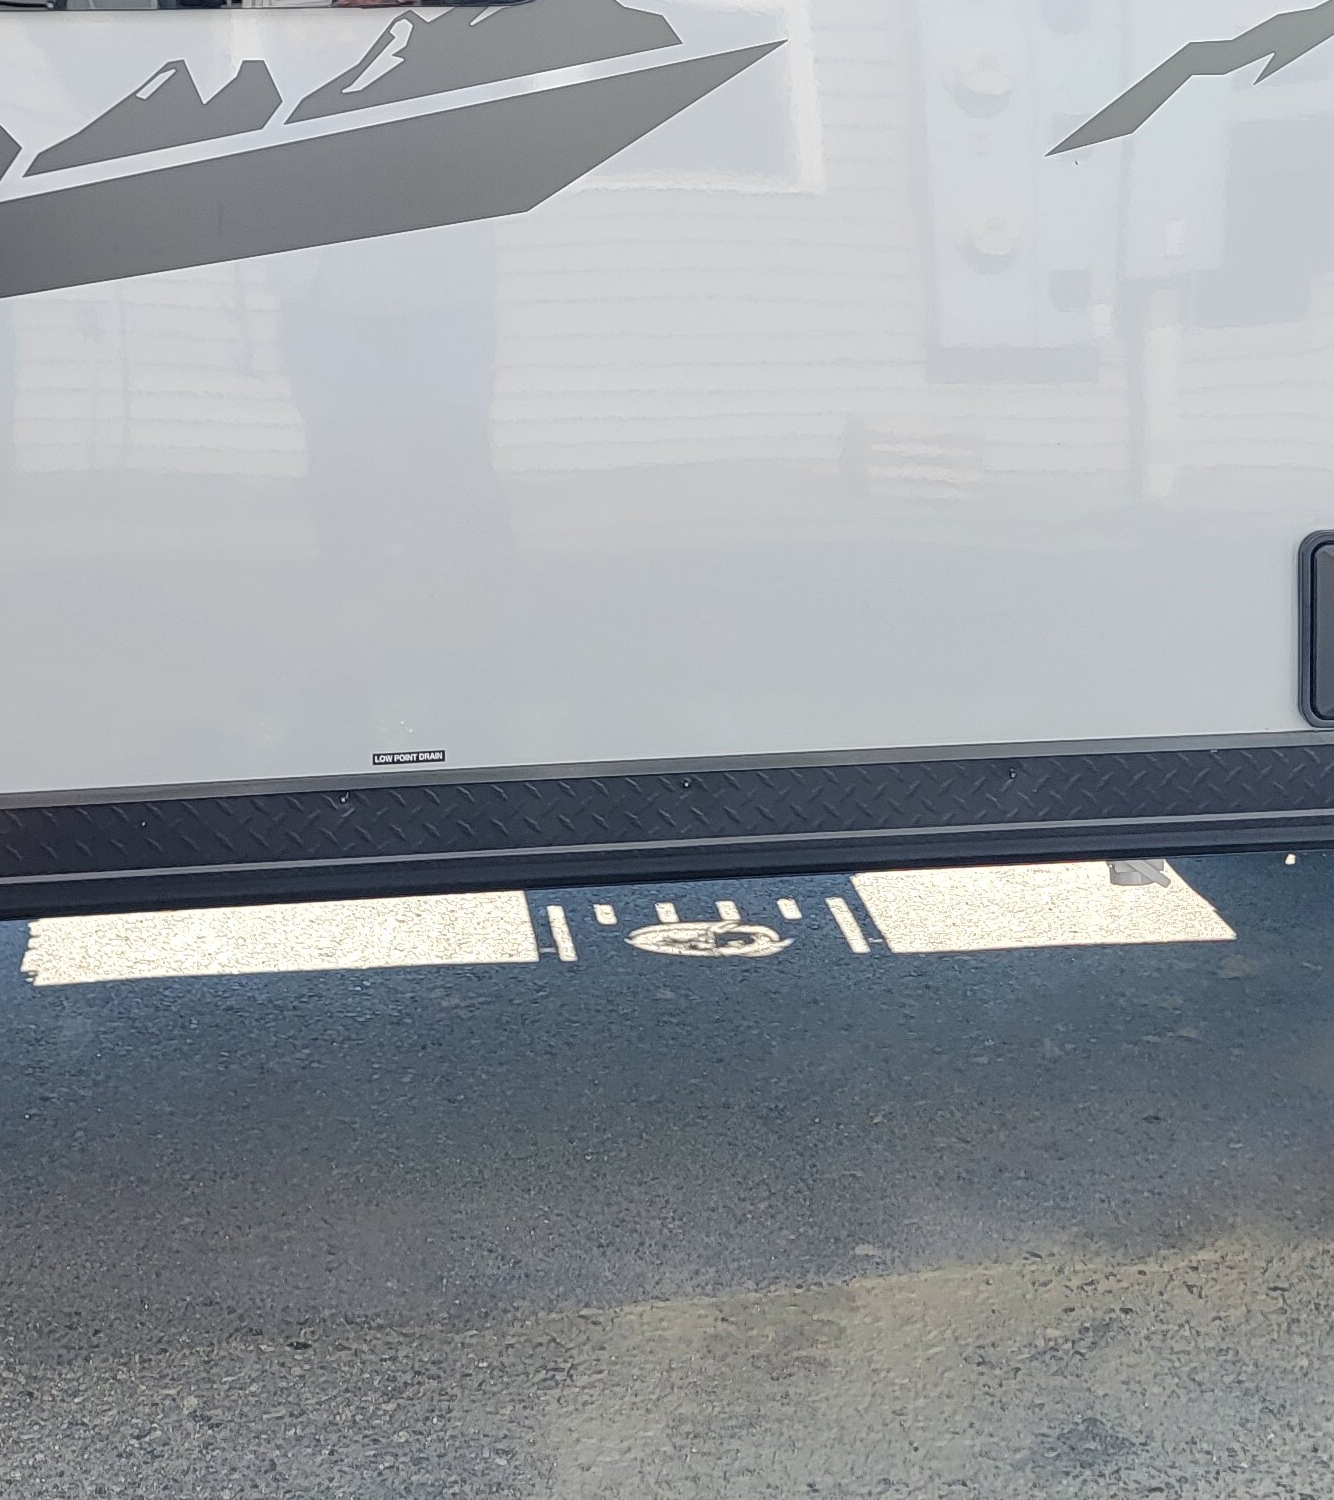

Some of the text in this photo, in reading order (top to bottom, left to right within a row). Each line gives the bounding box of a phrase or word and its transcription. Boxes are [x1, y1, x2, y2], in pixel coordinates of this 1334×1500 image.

[374, 752, 443, 763] LOW POINT DRAIN
